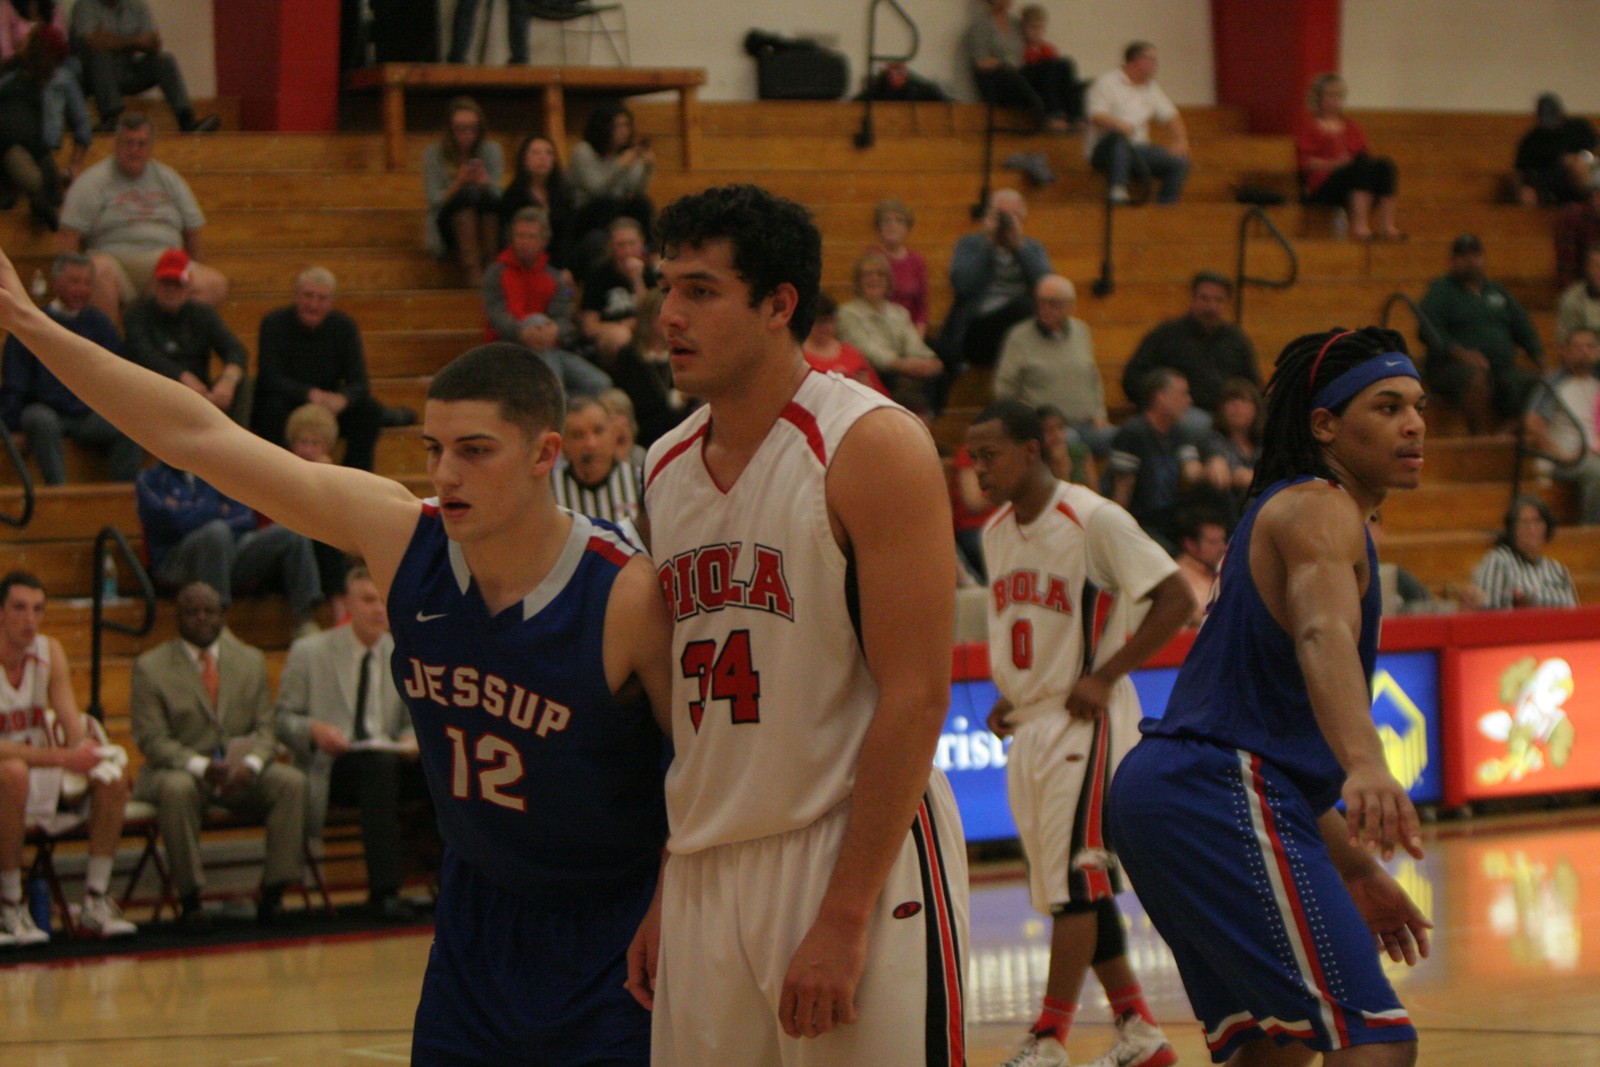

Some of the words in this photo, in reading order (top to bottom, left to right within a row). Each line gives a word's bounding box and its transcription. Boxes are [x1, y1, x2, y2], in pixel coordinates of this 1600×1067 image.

[992, 568, 1074, 617] BOLA
[681, 629, 761, 735] 34
[1011, 619, 1034, 671] 0
[403, 657, 573, 739] JESSUP
[444, 725, 528, 814] 12
